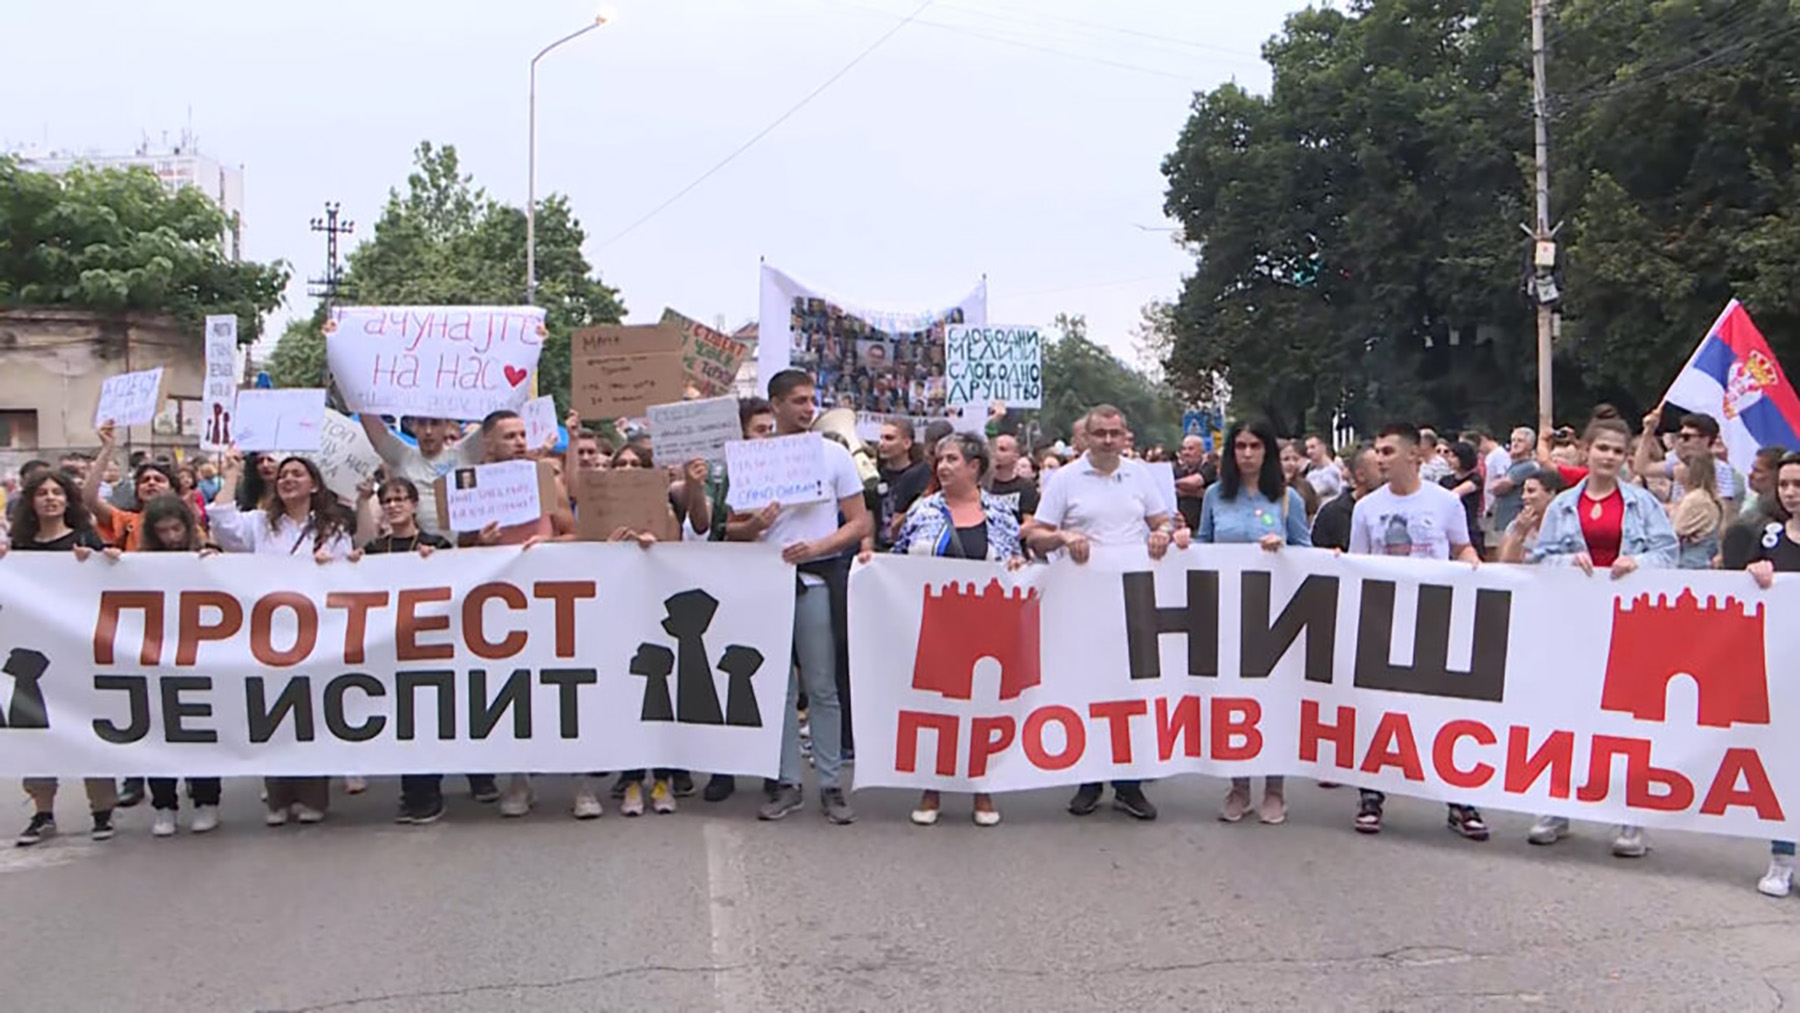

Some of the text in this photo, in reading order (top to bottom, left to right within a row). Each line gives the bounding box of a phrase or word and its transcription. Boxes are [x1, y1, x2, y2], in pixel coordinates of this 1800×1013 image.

[947, 343, 1037, 362] МЕДИЈИ
[948, 327, 1039, 346] СЛОБОДНИ
[947, 381, 1040, 404] ДРУШТВО
[948, 362, 1040, 382] СЛОБОДНО
[93, 581, 597, 667] ПРОТЕСТ
[1121, 568, 1513, 704] НИШ
[92, 668, 598, 744] ЈЕ ИСПИТ
[895, 695, 1787, 823] ПРОТИВ НАСИЉА
